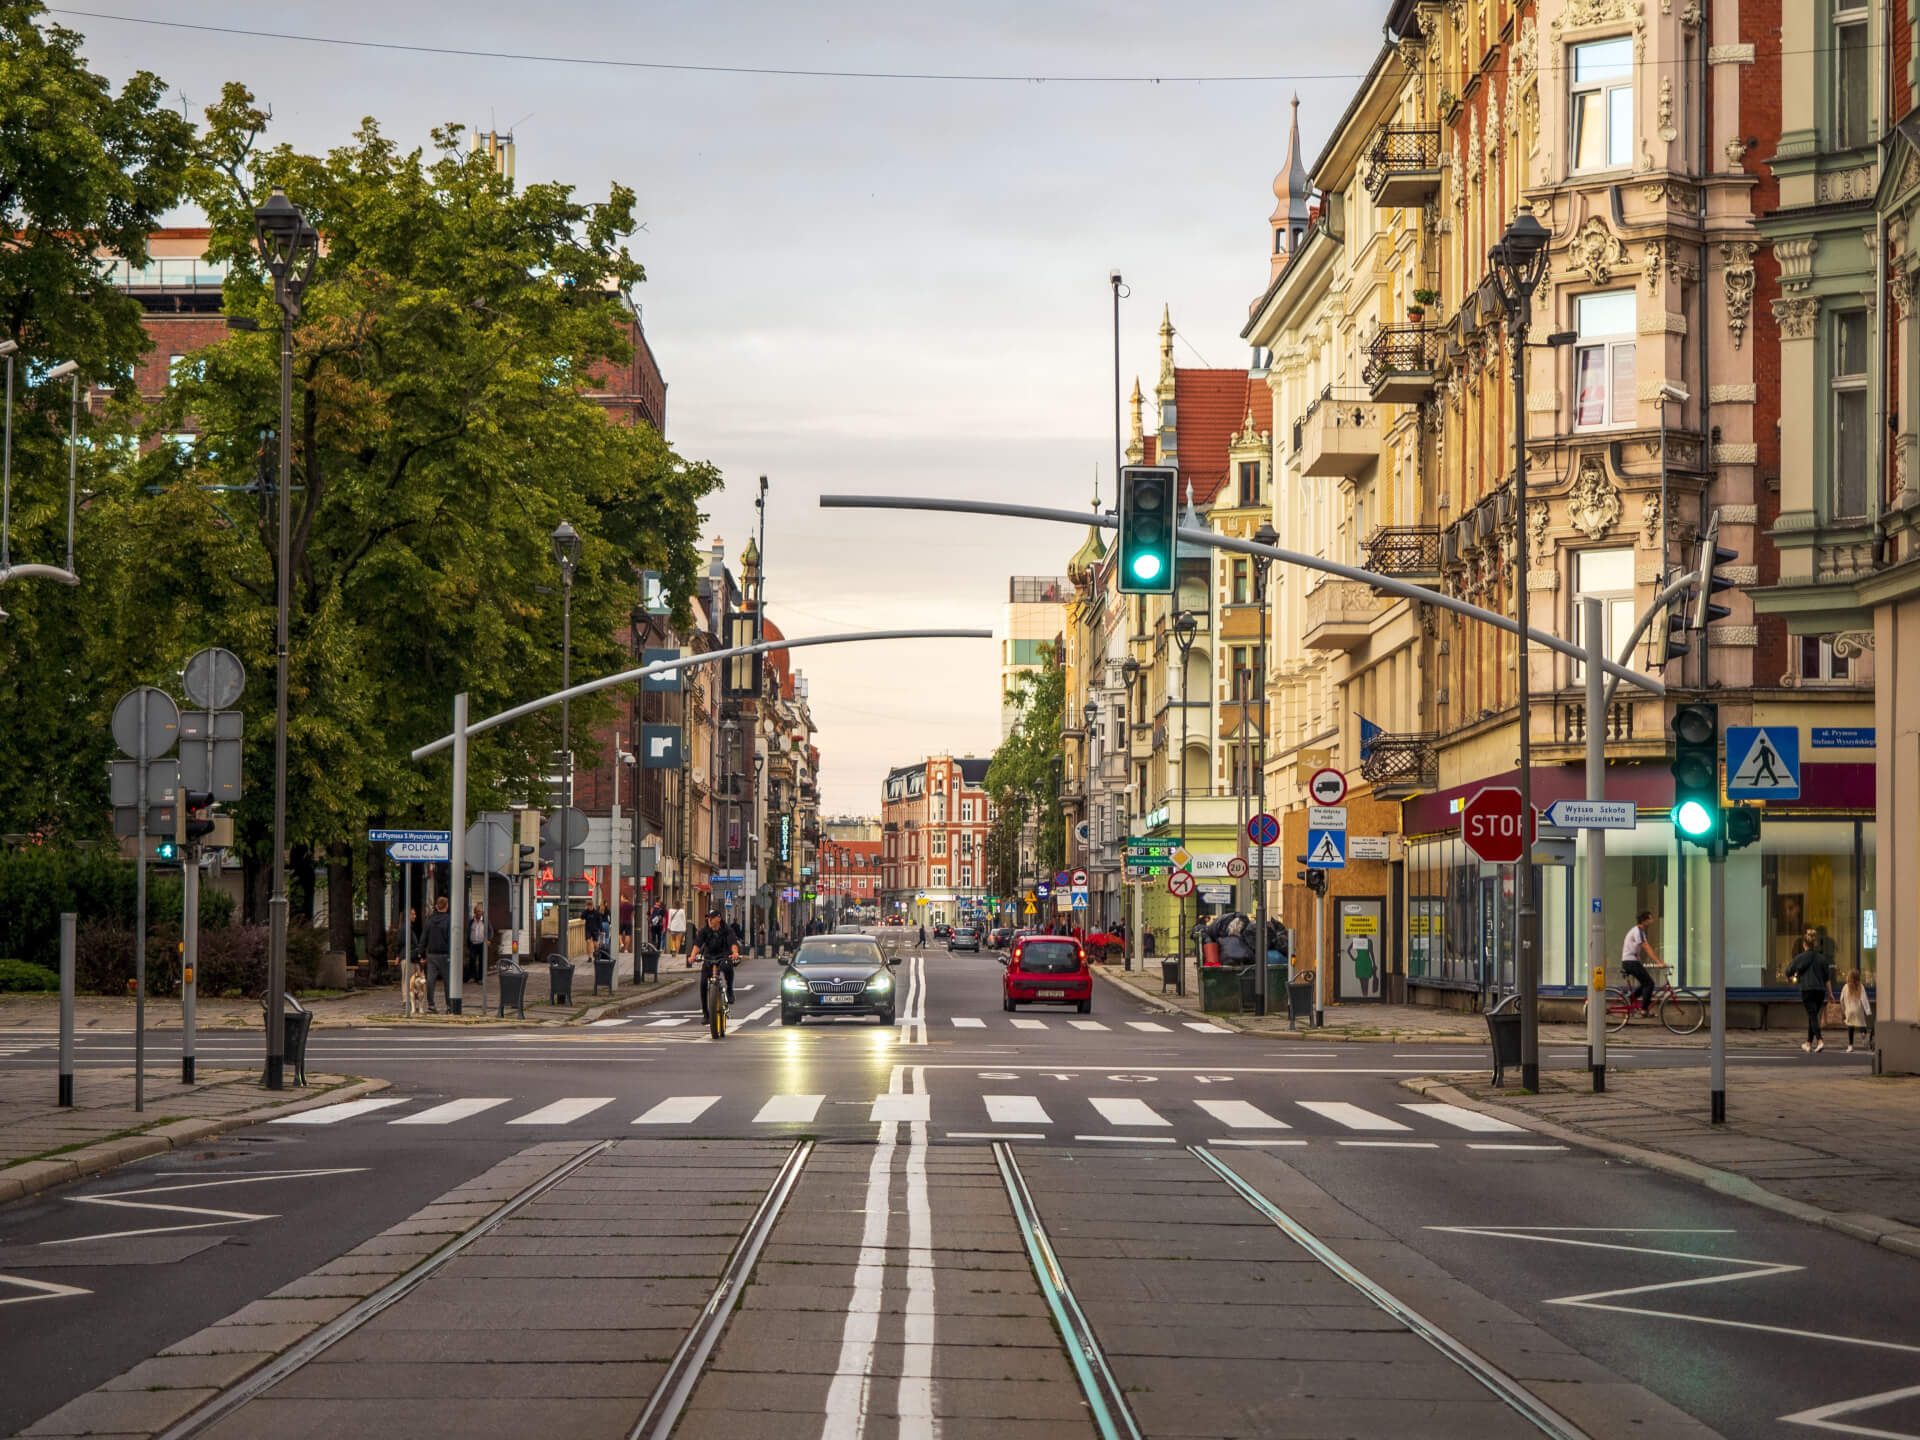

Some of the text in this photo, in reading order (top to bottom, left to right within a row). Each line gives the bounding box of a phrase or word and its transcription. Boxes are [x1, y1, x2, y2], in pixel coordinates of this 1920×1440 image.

[1565, 805, 1626, 815] Wyższa Szkoła
[1564, 814, 1626, 824] Bezpieczeństwa
[402, 844, 440, 852] POLICJA
[1149, 847, 1160, 856] 52
[1196, 861, 1227, 869] BNP PA
[1149, 866, 1160, 875] 22
[976, 1072, 1235, 1083] STOP
